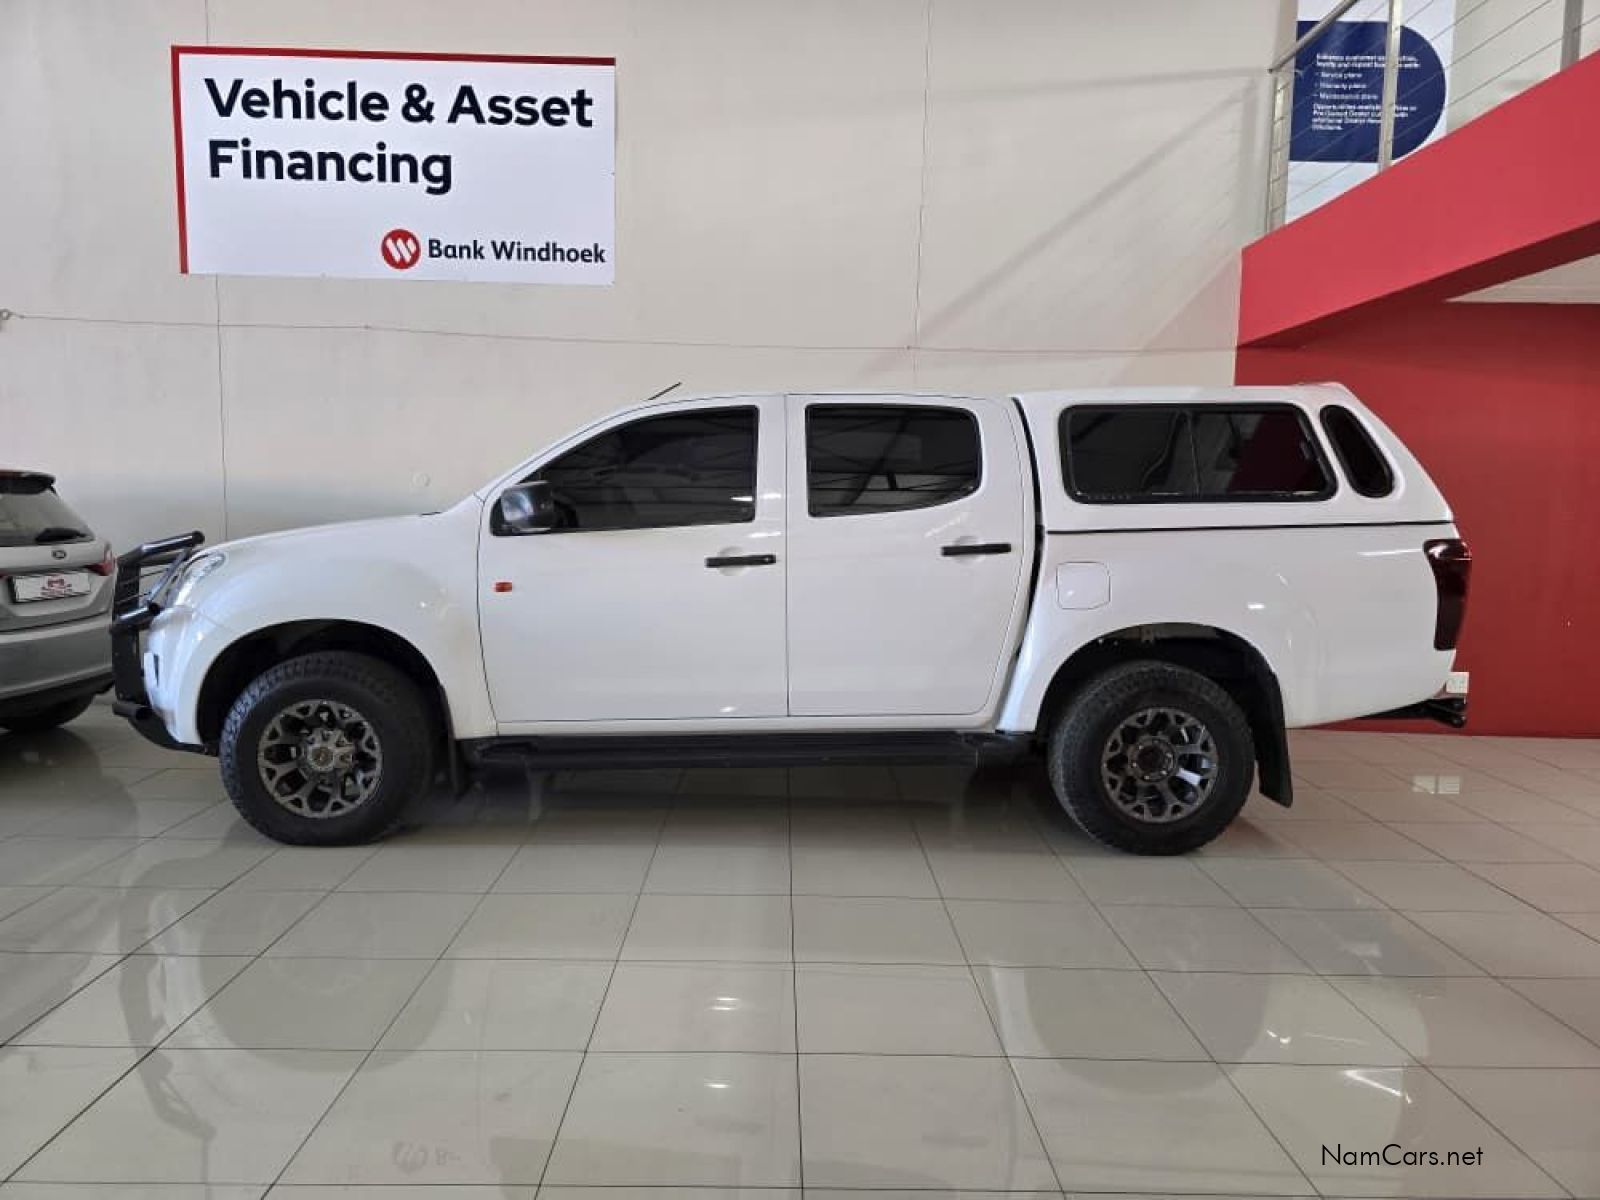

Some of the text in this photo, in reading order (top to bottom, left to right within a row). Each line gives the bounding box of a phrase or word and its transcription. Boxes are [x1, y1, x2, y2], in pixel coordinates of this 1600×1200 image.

[204, 77, 593, 128] Vehicle & Asset
[209, 137, 452, 196] Financing
[428, 237, 486, 260] Bank
[490, 239, 606, 264] Windhoek
